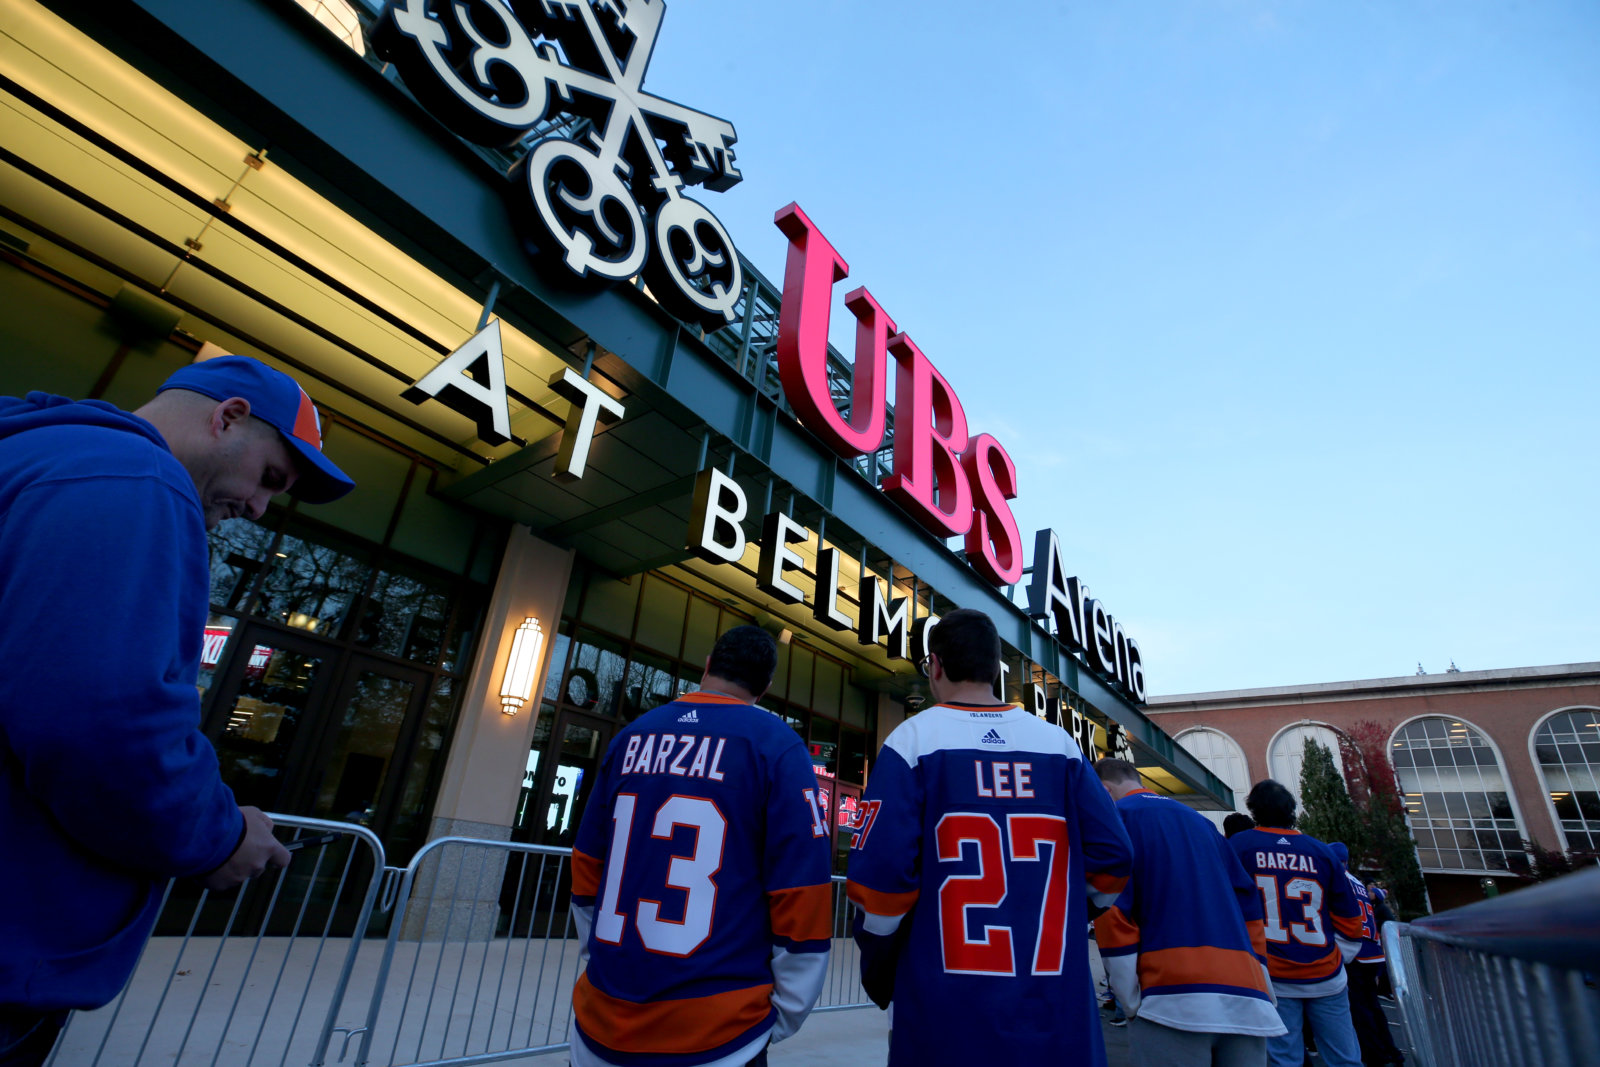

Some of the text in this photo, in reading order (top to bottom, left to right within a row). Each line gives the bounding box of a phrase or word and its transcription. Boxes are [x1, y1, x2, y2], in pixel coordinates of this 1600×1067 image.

[776, 201, 1149, 705] UBS Arena
[408, 317, 627, 481] AT
[700, 466, 1010, 702] BELMT
[621, 734, 726, 782] BARZAL
[974, 760, 1035, 799] LEE
[595, 793, 728, 958] 13
[935, 812, 1070, 977] 27
[1255, 851, 1318, 874] BARZAL
[1356, 885, 1368, 897] LEE
[1255, 874, 1328, 947] 13
